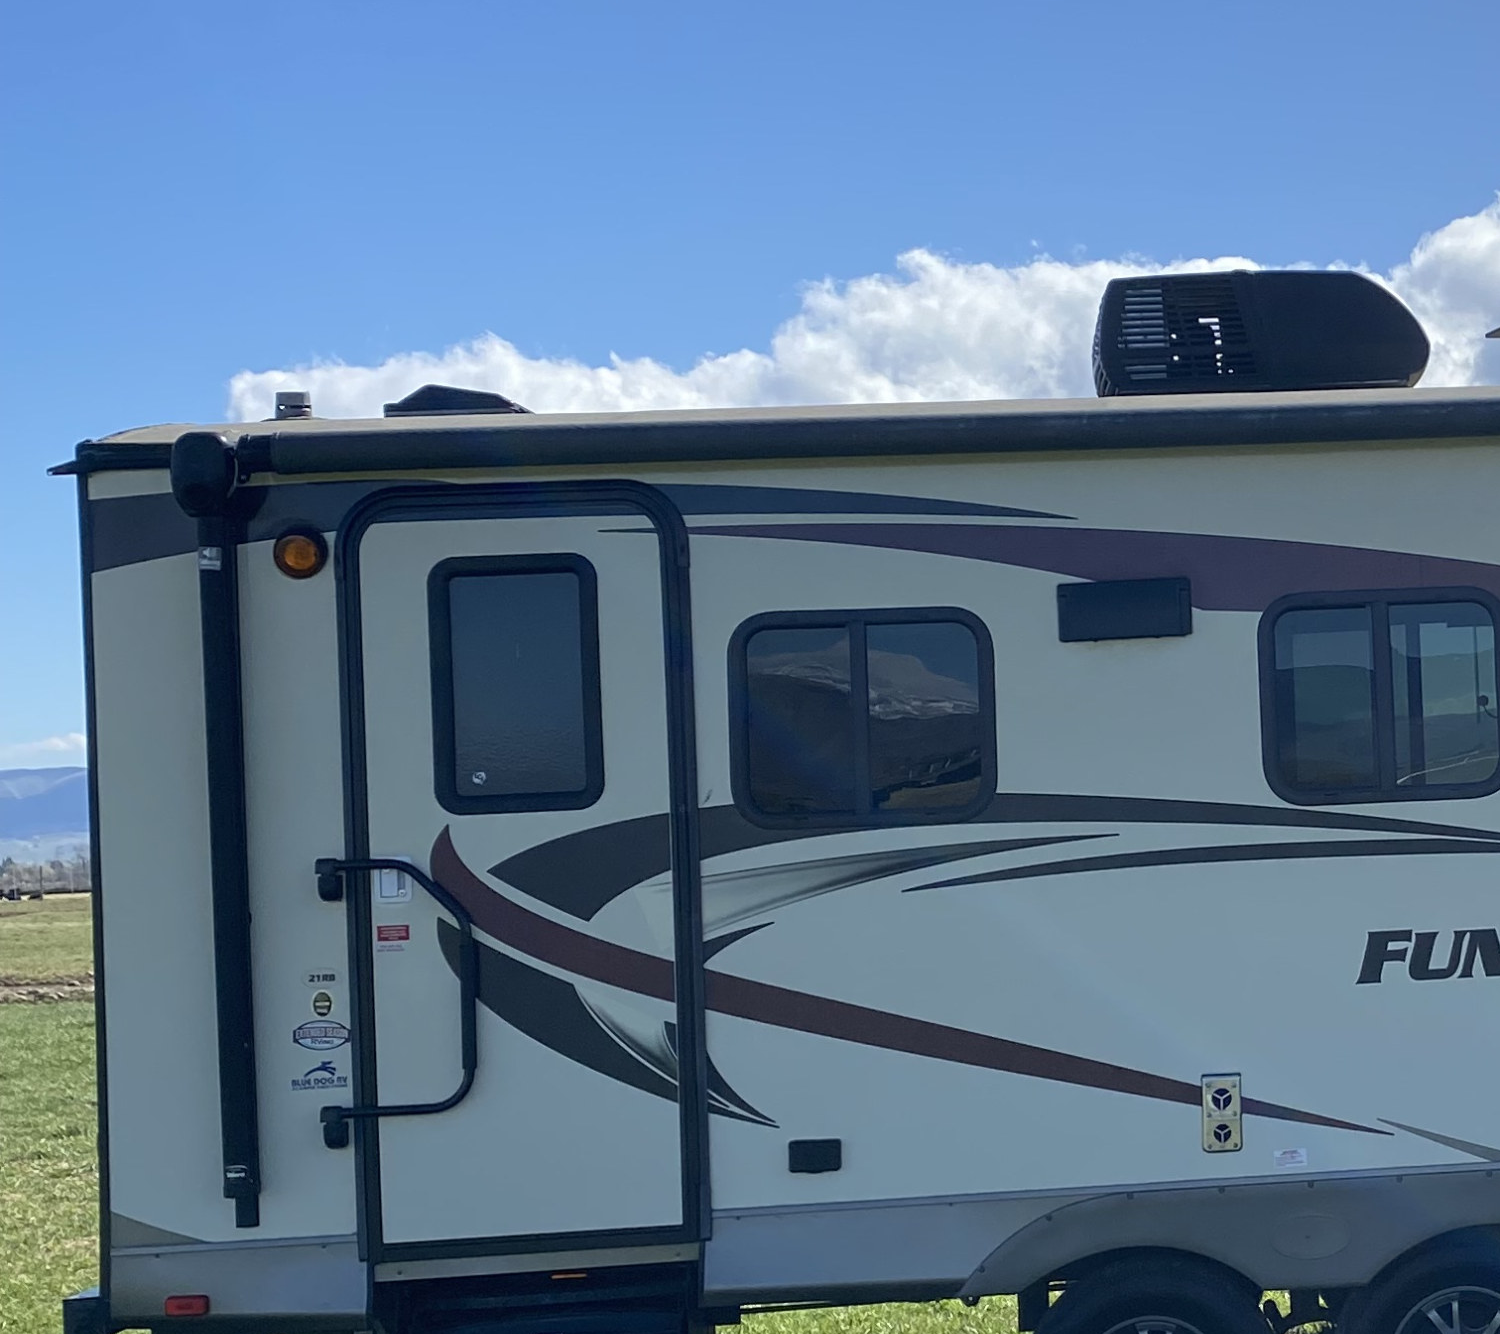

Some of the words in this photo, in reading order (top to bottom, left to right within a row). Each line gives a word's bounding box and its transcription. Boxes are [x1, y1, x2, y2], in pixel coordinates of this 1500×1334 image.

[291, 1078, 312, 1087] BLUE
[313, 1077, 335, 1085] DOG
[336, 1075, 348, 1084] RV
